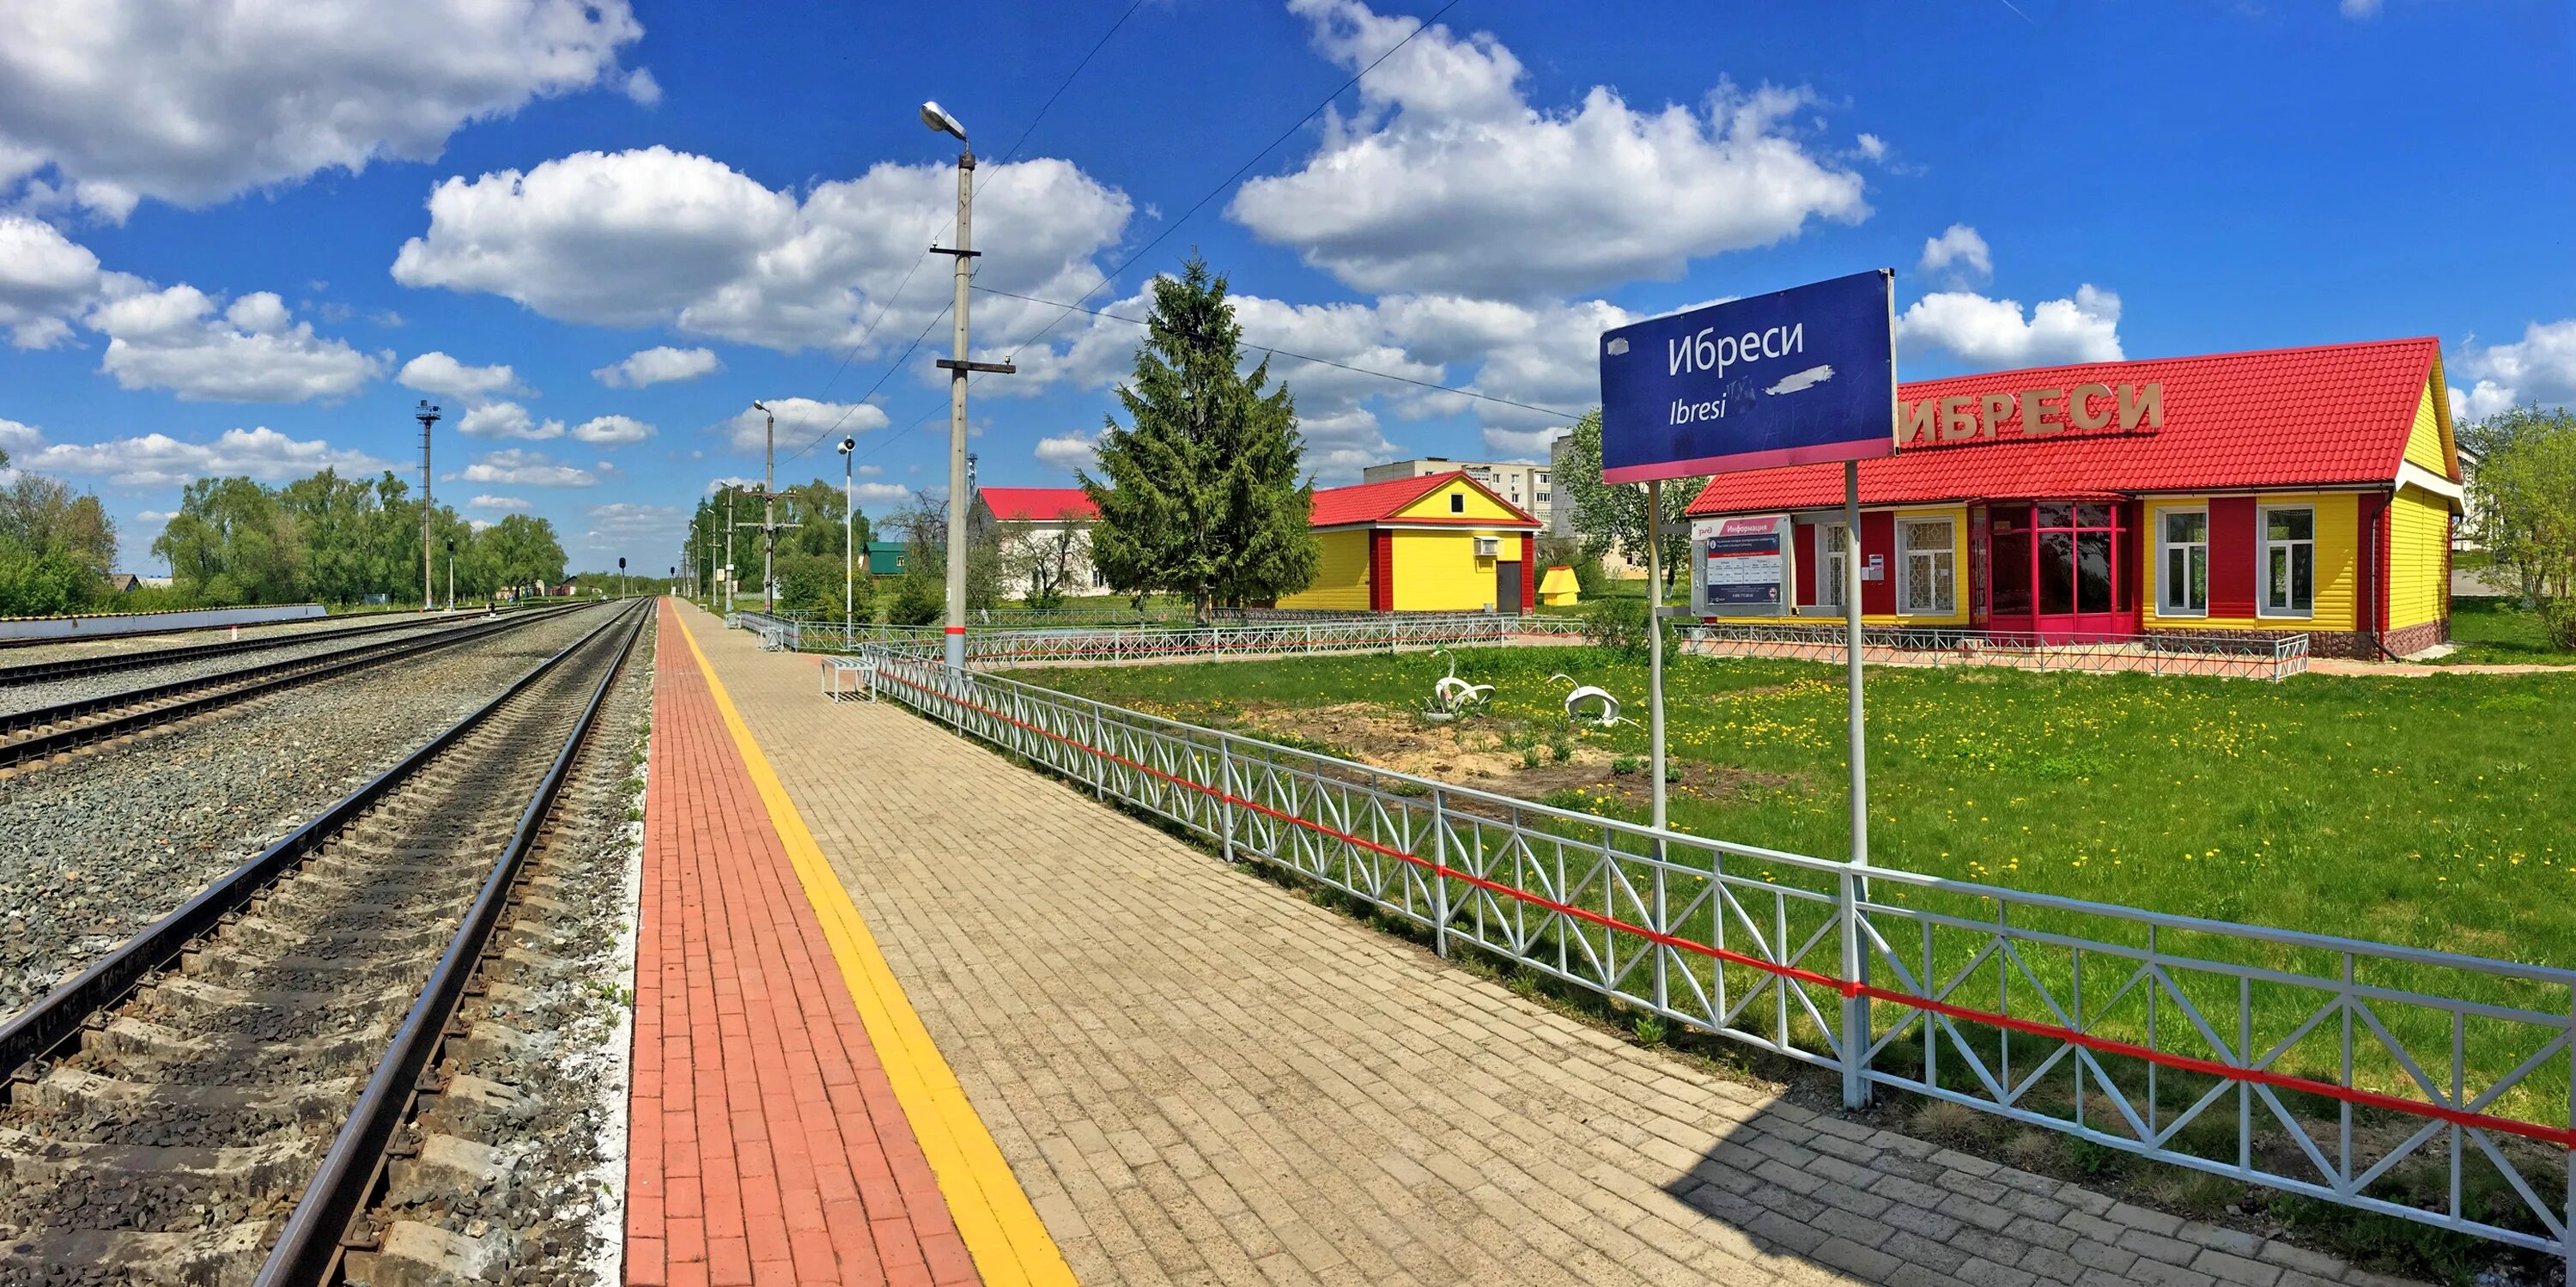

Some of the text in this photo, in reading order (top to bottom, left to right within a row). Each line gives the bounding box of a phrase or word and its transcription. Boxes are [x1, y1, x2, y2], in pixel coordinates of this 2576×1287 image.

[1668, 322, 1804, 379] Ибреси
[1669, 392, 1727, 426] Ibresi
[1899, 381, 2164, 443] ИБРЕСИ
[1727, 524, 1768, 534] Информация
